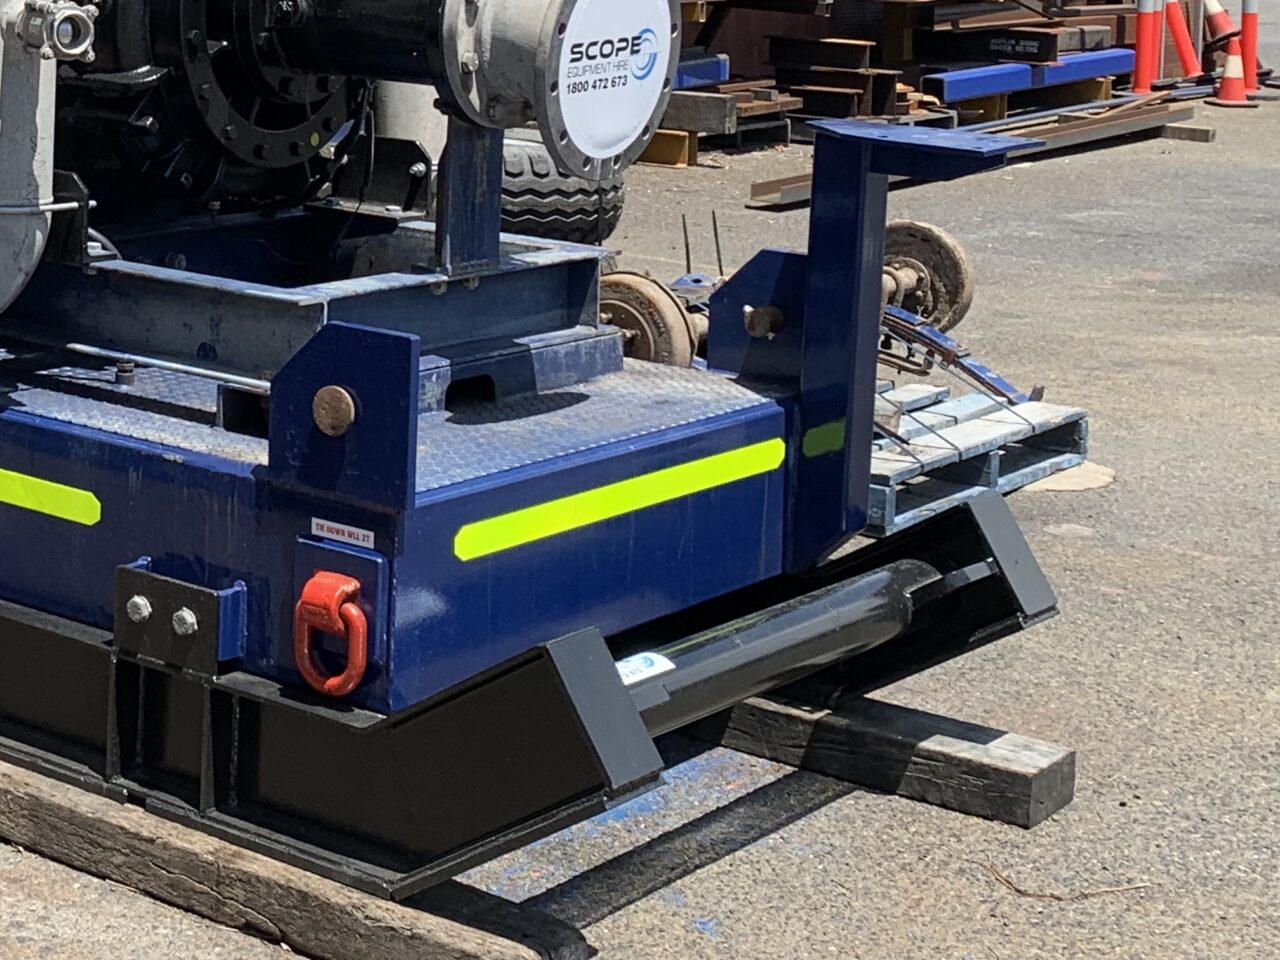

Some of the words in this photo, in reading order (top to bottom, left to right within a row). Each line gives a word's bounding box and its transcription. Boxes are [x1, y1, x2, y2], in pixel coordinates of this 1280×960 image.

[569, 35, 642, 64] SCOPE
[567, 61, 613, 79] EQUIPMENT
[612, 59, 629, 72] HIRE
[566, 80, 590, 95] 1800
[591, 78, 609, 91] 472
[610, 75, 628, 89] 673
